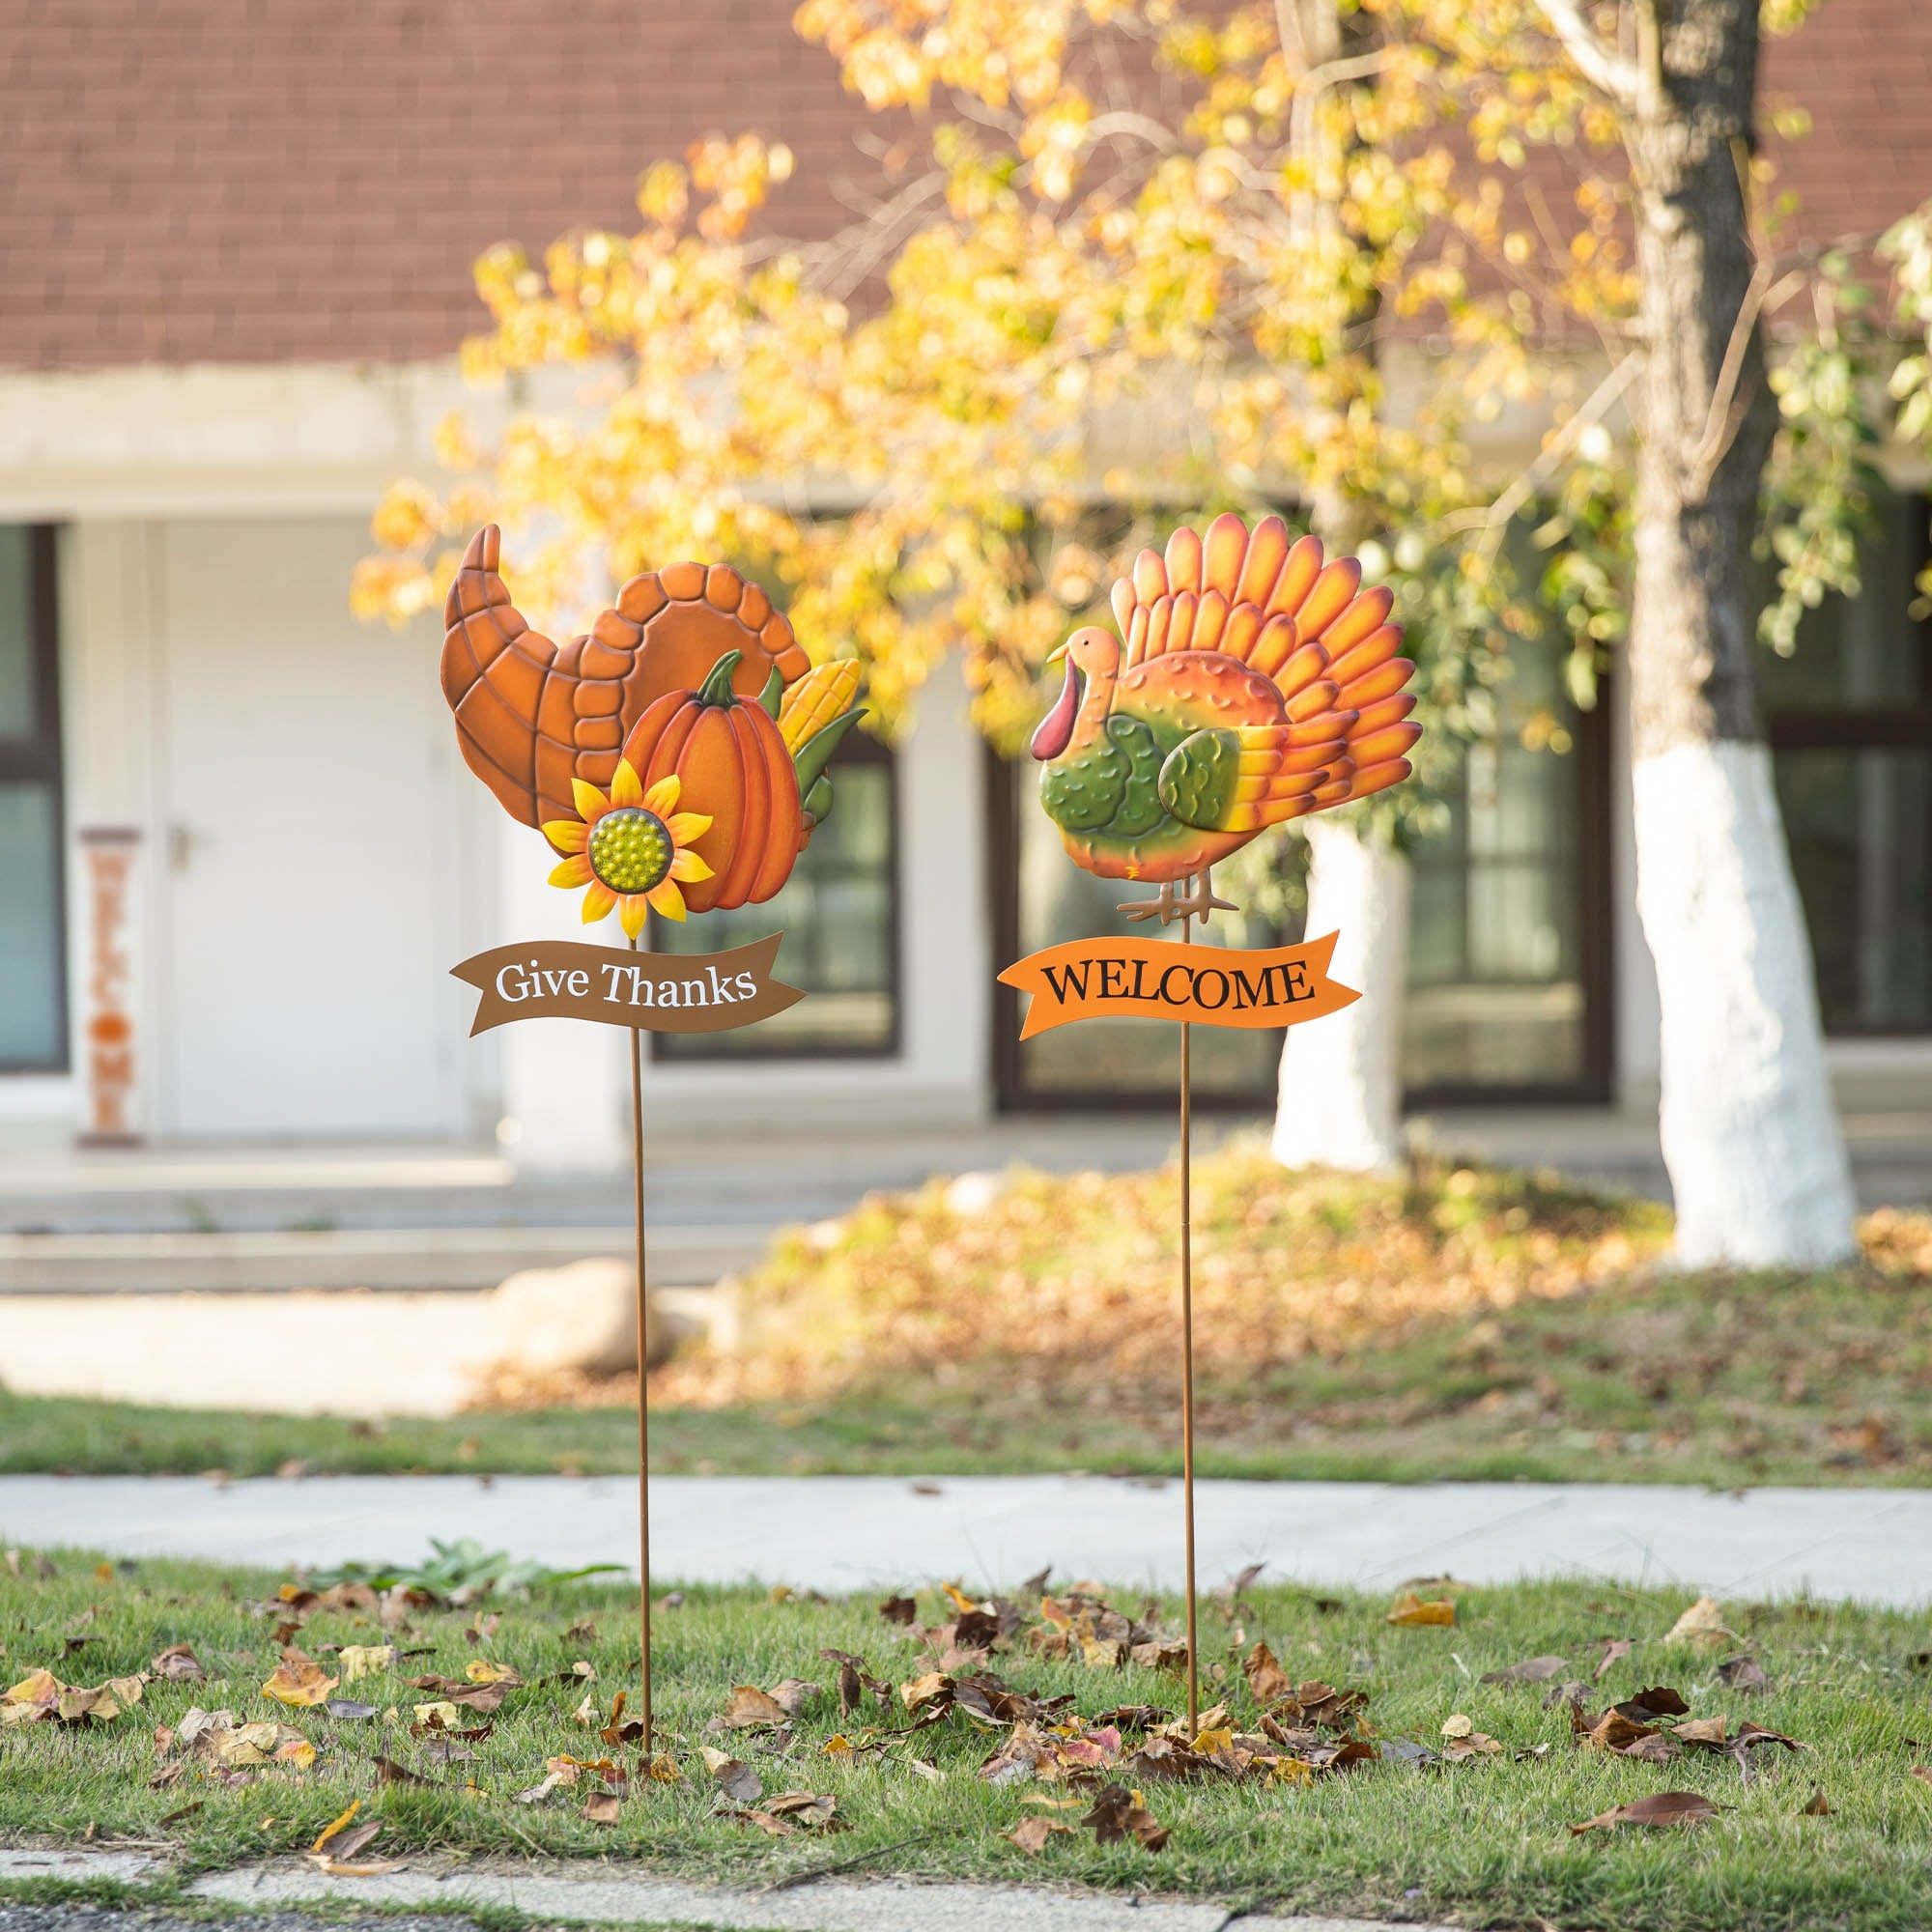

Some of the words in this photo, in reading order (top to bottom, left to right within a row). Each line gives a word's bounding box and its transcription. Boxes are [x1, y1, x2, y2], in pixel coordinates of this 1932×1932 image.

[496, 959, 589, 1003] Give
[601, 963, 757, 1008] Thanks
[1040, 959, 1316, 1010] WELCOME
